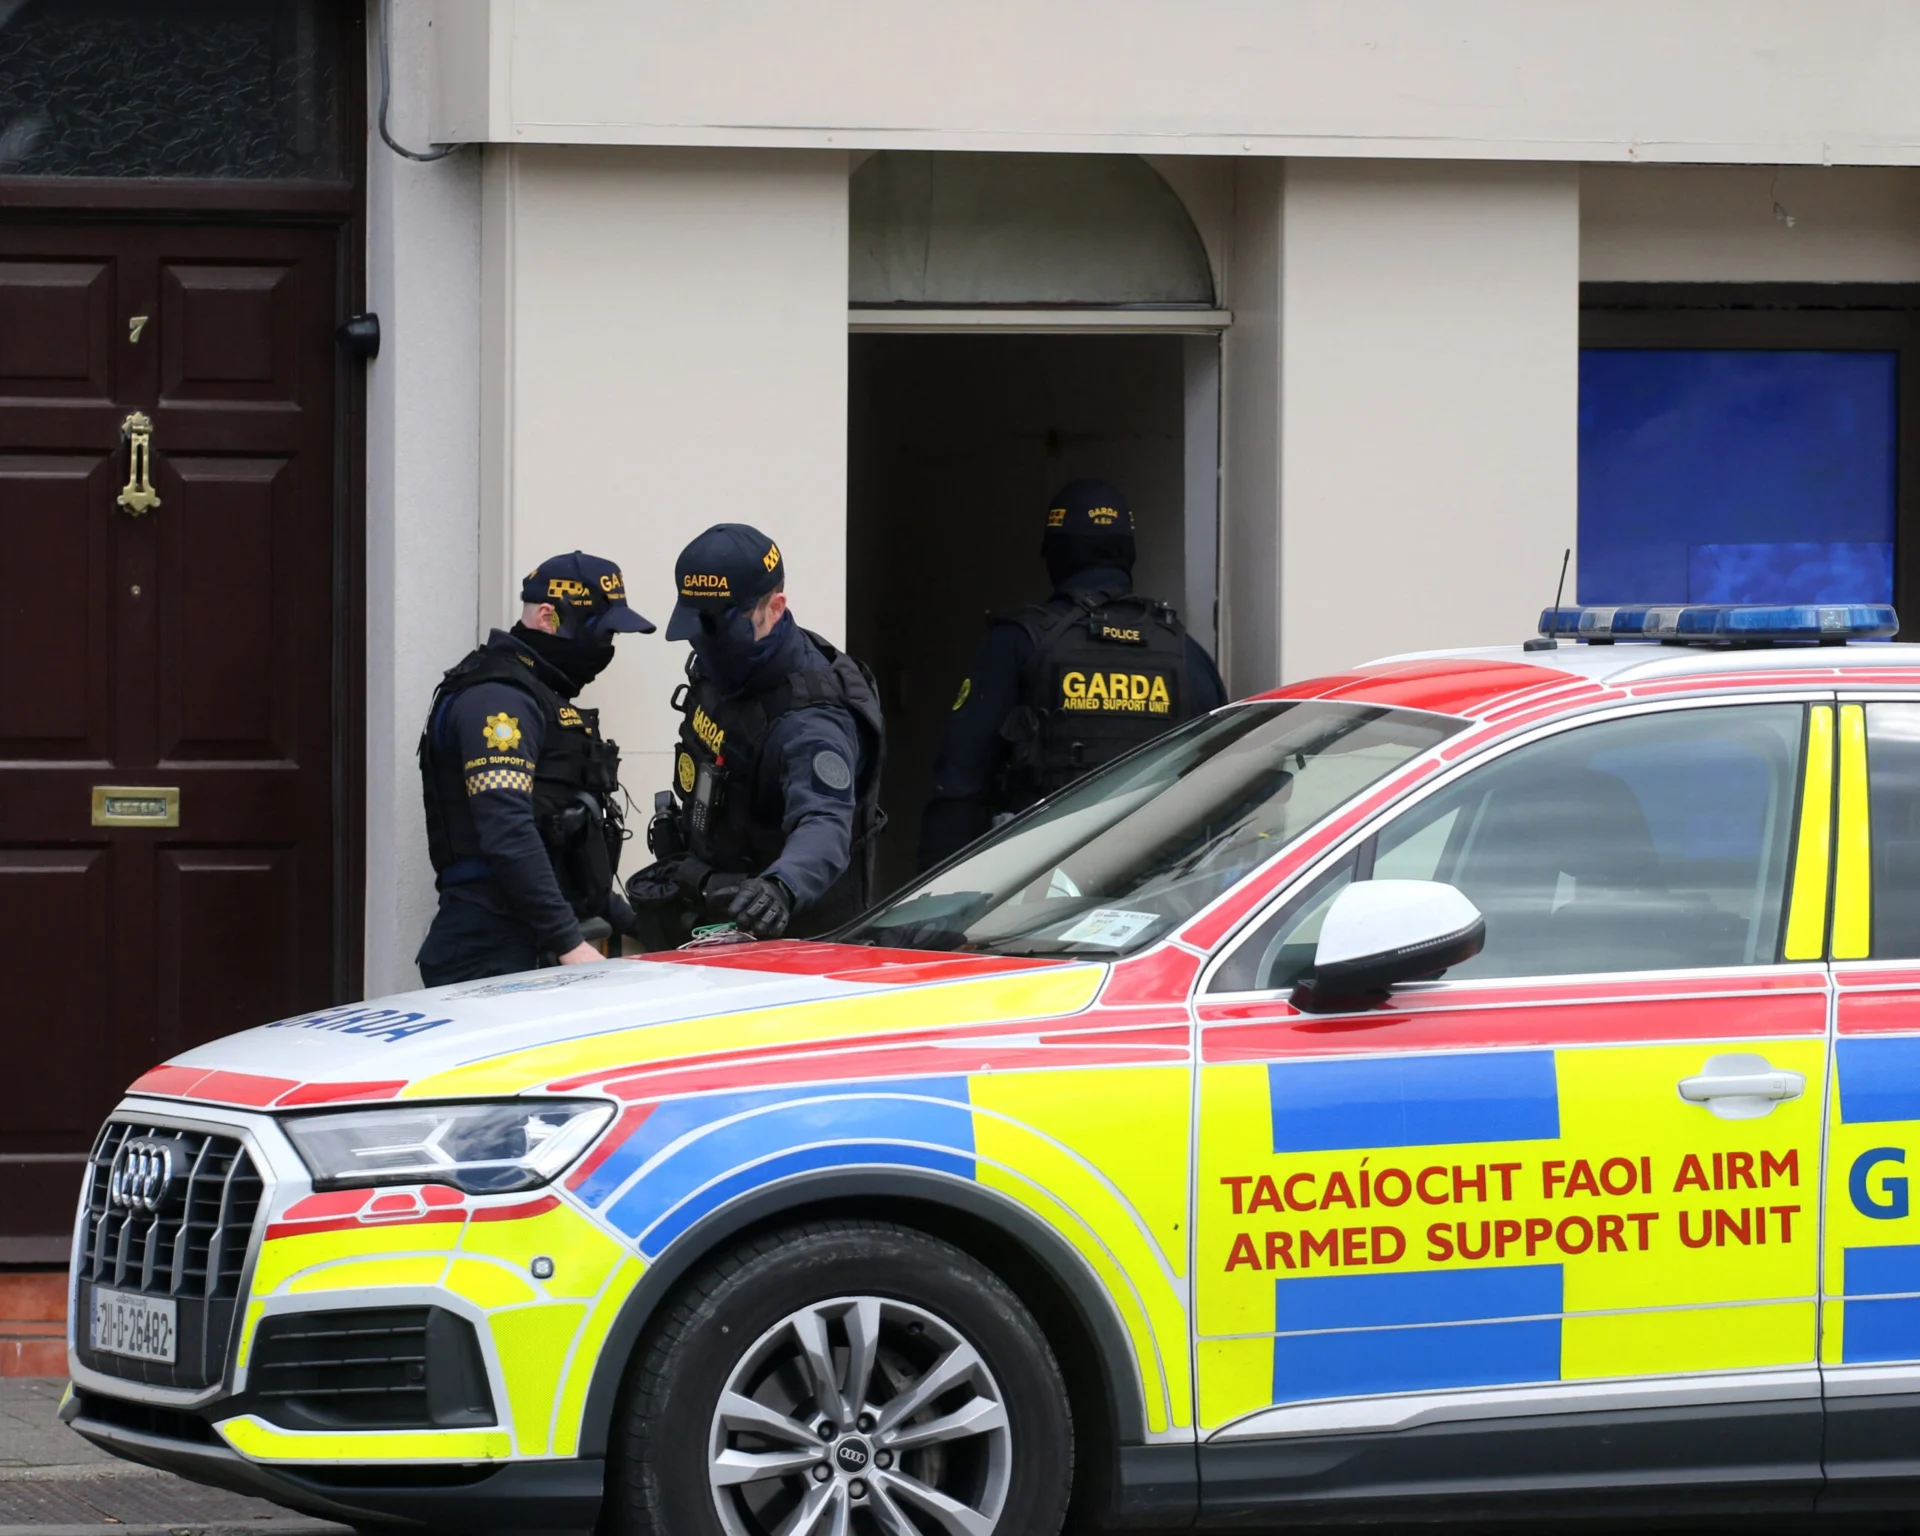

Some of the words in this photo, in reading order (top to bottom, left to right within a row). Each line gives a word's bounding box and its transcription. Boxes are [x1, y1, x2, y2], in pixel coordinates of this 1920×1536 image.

[129, 316, 149, 343] 7
[1088, 507, 1118, 518] GARDA
[684, 574, 728, 589] GARDA
[1103, 626, 1140, 640] POLICE
[1063, 671, 1169, 702] GARDA
[1063, 698, 1099, 709] ARMED
[1103, 698, 1146, 711] SUPPORT
[1149, 701, 1170, 713] UNIT
[489, 756, 525, 767] SUPPORT
[266, 1007, 455, 1043] GARDA
[1220, 1157, 1522, 1214] TACAÍOCHT
[1542, 1156, 1652, 1199] FAOI
[1673, 1149, 1799, 1192] AIRM
[1848, 1147, 1909, 1219] G
[1224, 1226, 1406, 1272] ARMED
[1426, 1212, 1659, 1262] SUPPORT
[1679, 1205, 1800, 1248] UNIT
[100, 1303, 168, 1356] 211-D-26482
